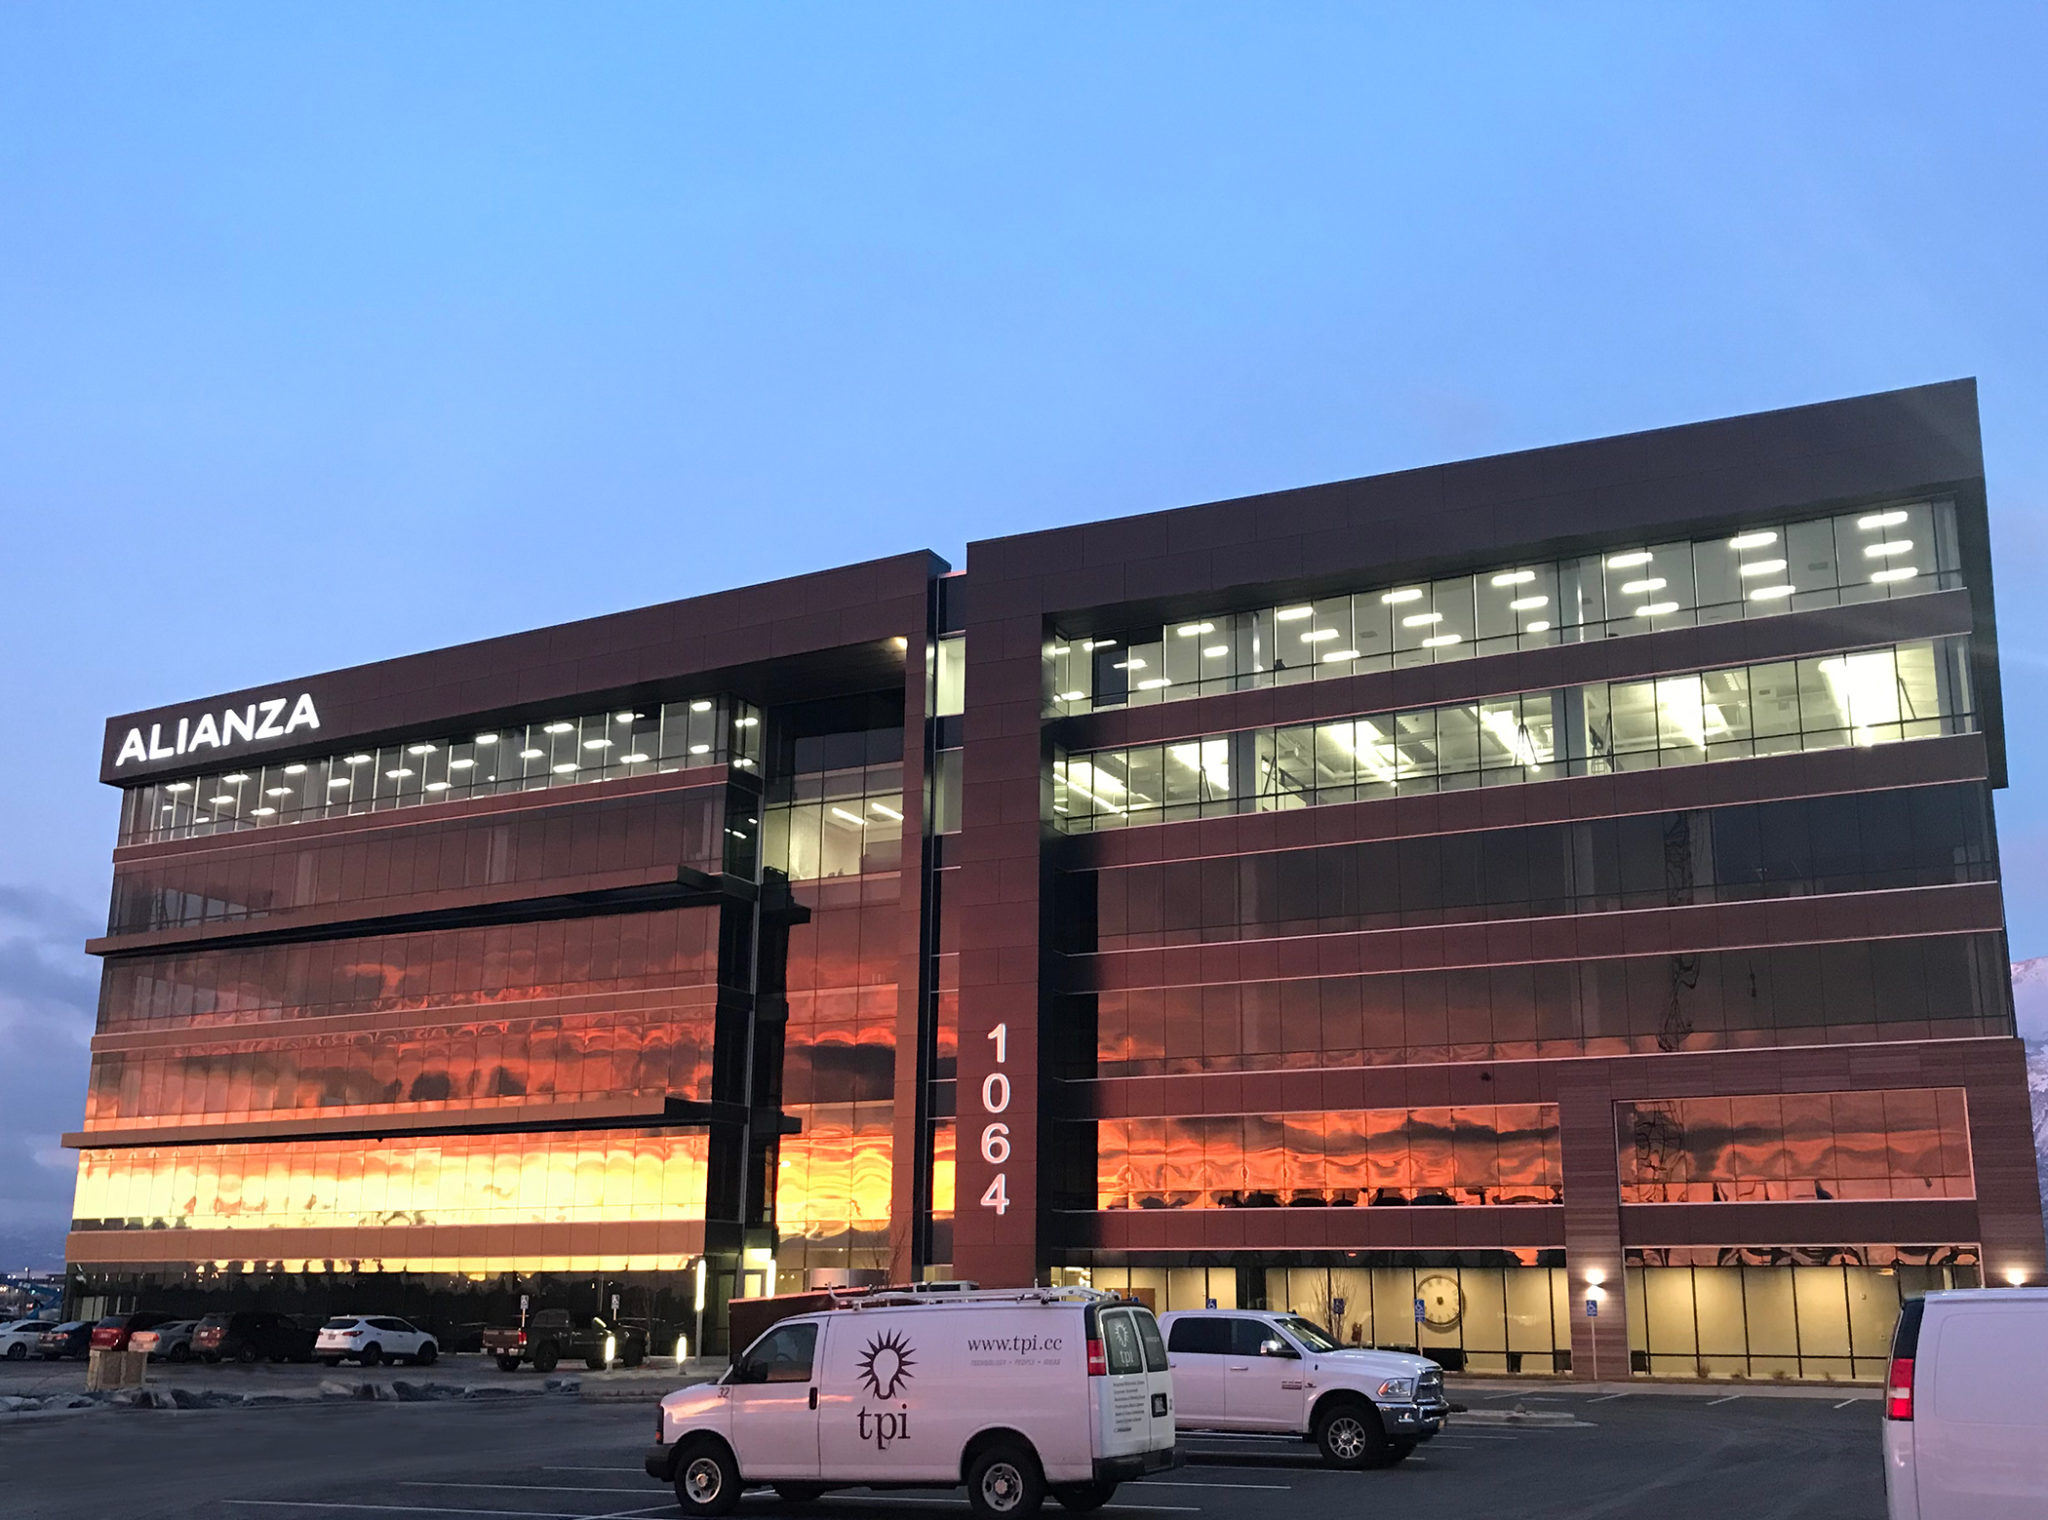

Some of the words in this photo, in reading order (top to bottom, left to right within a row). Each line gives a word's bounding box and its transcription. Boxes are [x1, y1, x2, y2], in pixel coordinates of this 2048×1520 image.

[115, 693, 321, 767] ALIANZA
[980, 1023, 1011, 1215] 1064
[967, 1334, 1063, 1355] www.tpi.cc
[717, 1387, 730, 1399] 32
[857, 1403, 911, 1450] tpi
